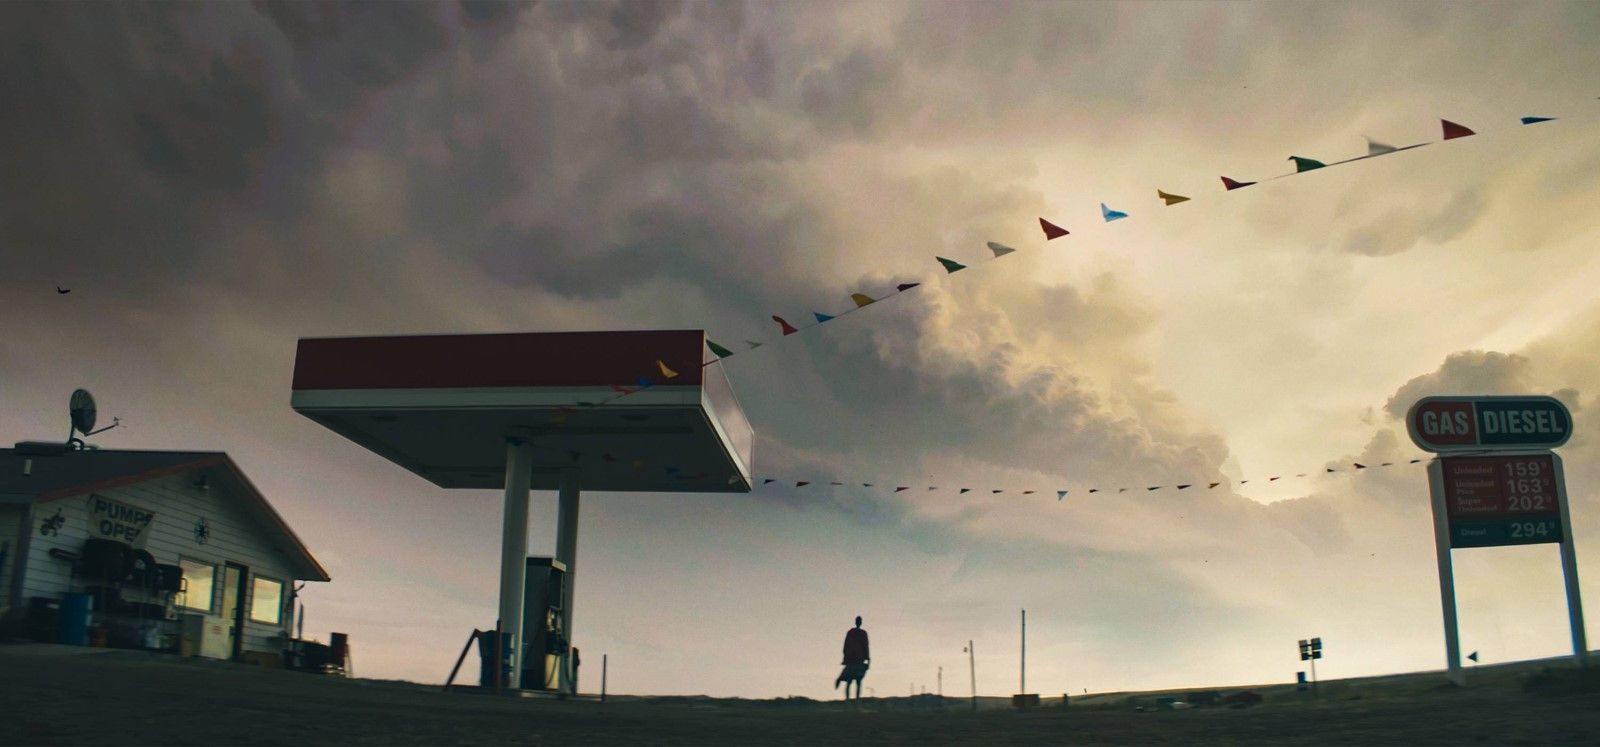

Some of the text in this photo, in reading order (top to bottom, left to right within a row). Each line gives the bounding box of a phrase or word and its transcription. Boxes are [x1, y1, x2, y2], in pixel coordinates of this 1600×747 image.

[1423, 411, 1469, 434] GAS
[1483, 410, 1563, 433] DIESEL
[1504, 461, 1540, 477] 159
[1506, 478, 1543, 494] 163
[1508, 495, 1545, 511] 202
[1511, 521, 1548, 538] 294
